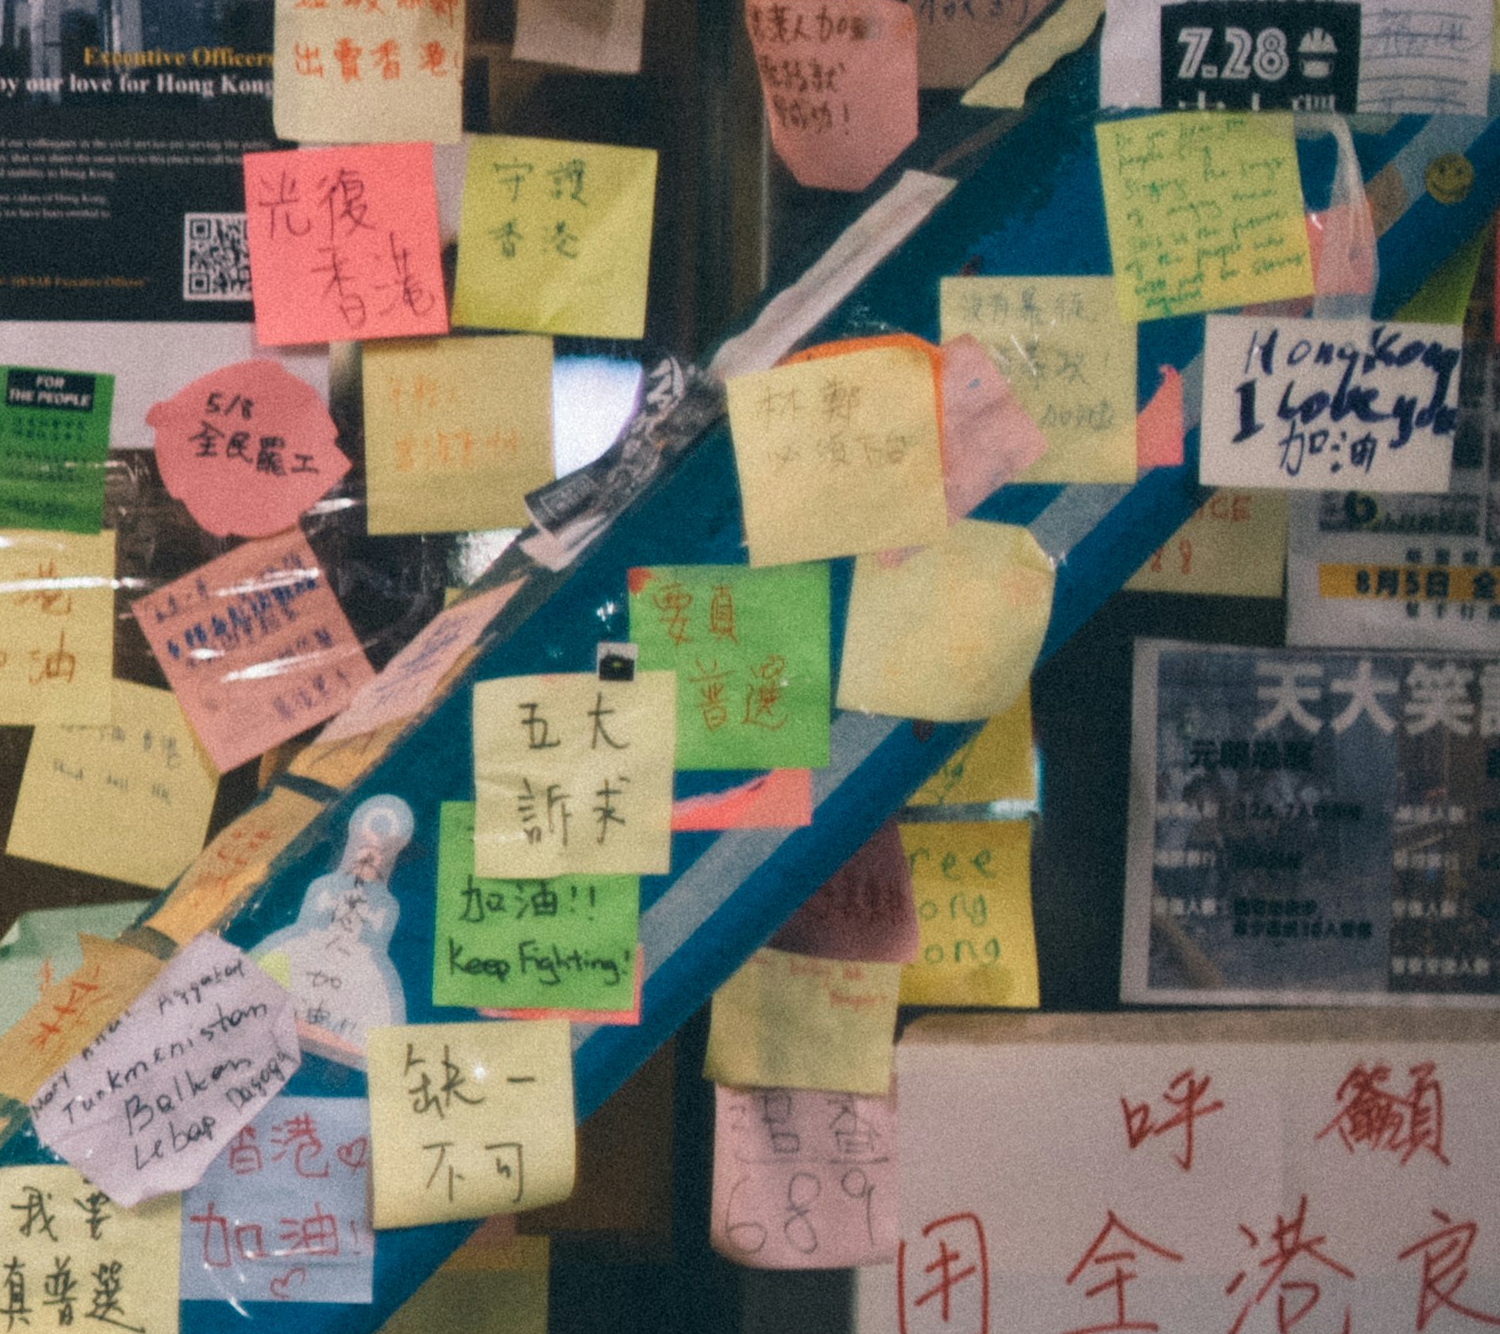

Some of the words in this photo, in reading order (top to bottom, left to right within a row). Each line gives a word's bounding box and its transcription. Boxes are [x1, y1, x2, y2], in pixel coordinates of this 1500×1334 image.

[1177, 28, 1291, 82] 7.28
[9, 389, 41, 405] THE
[43, 392, 92, 408] PEOPLE
[36, 375, 67, 389] FOR
[1276, 430, 1379, 474] 加油
[518, 694, 633, 754] 五大
[517, 776, 639, 846] 訴求
[518, 941, 632, 986] Fighting!
[228, 1118, 330, 1178] 香港
[422, 1141, 526, 1204] 不可
[726, 1164, 882, 1258] 689
